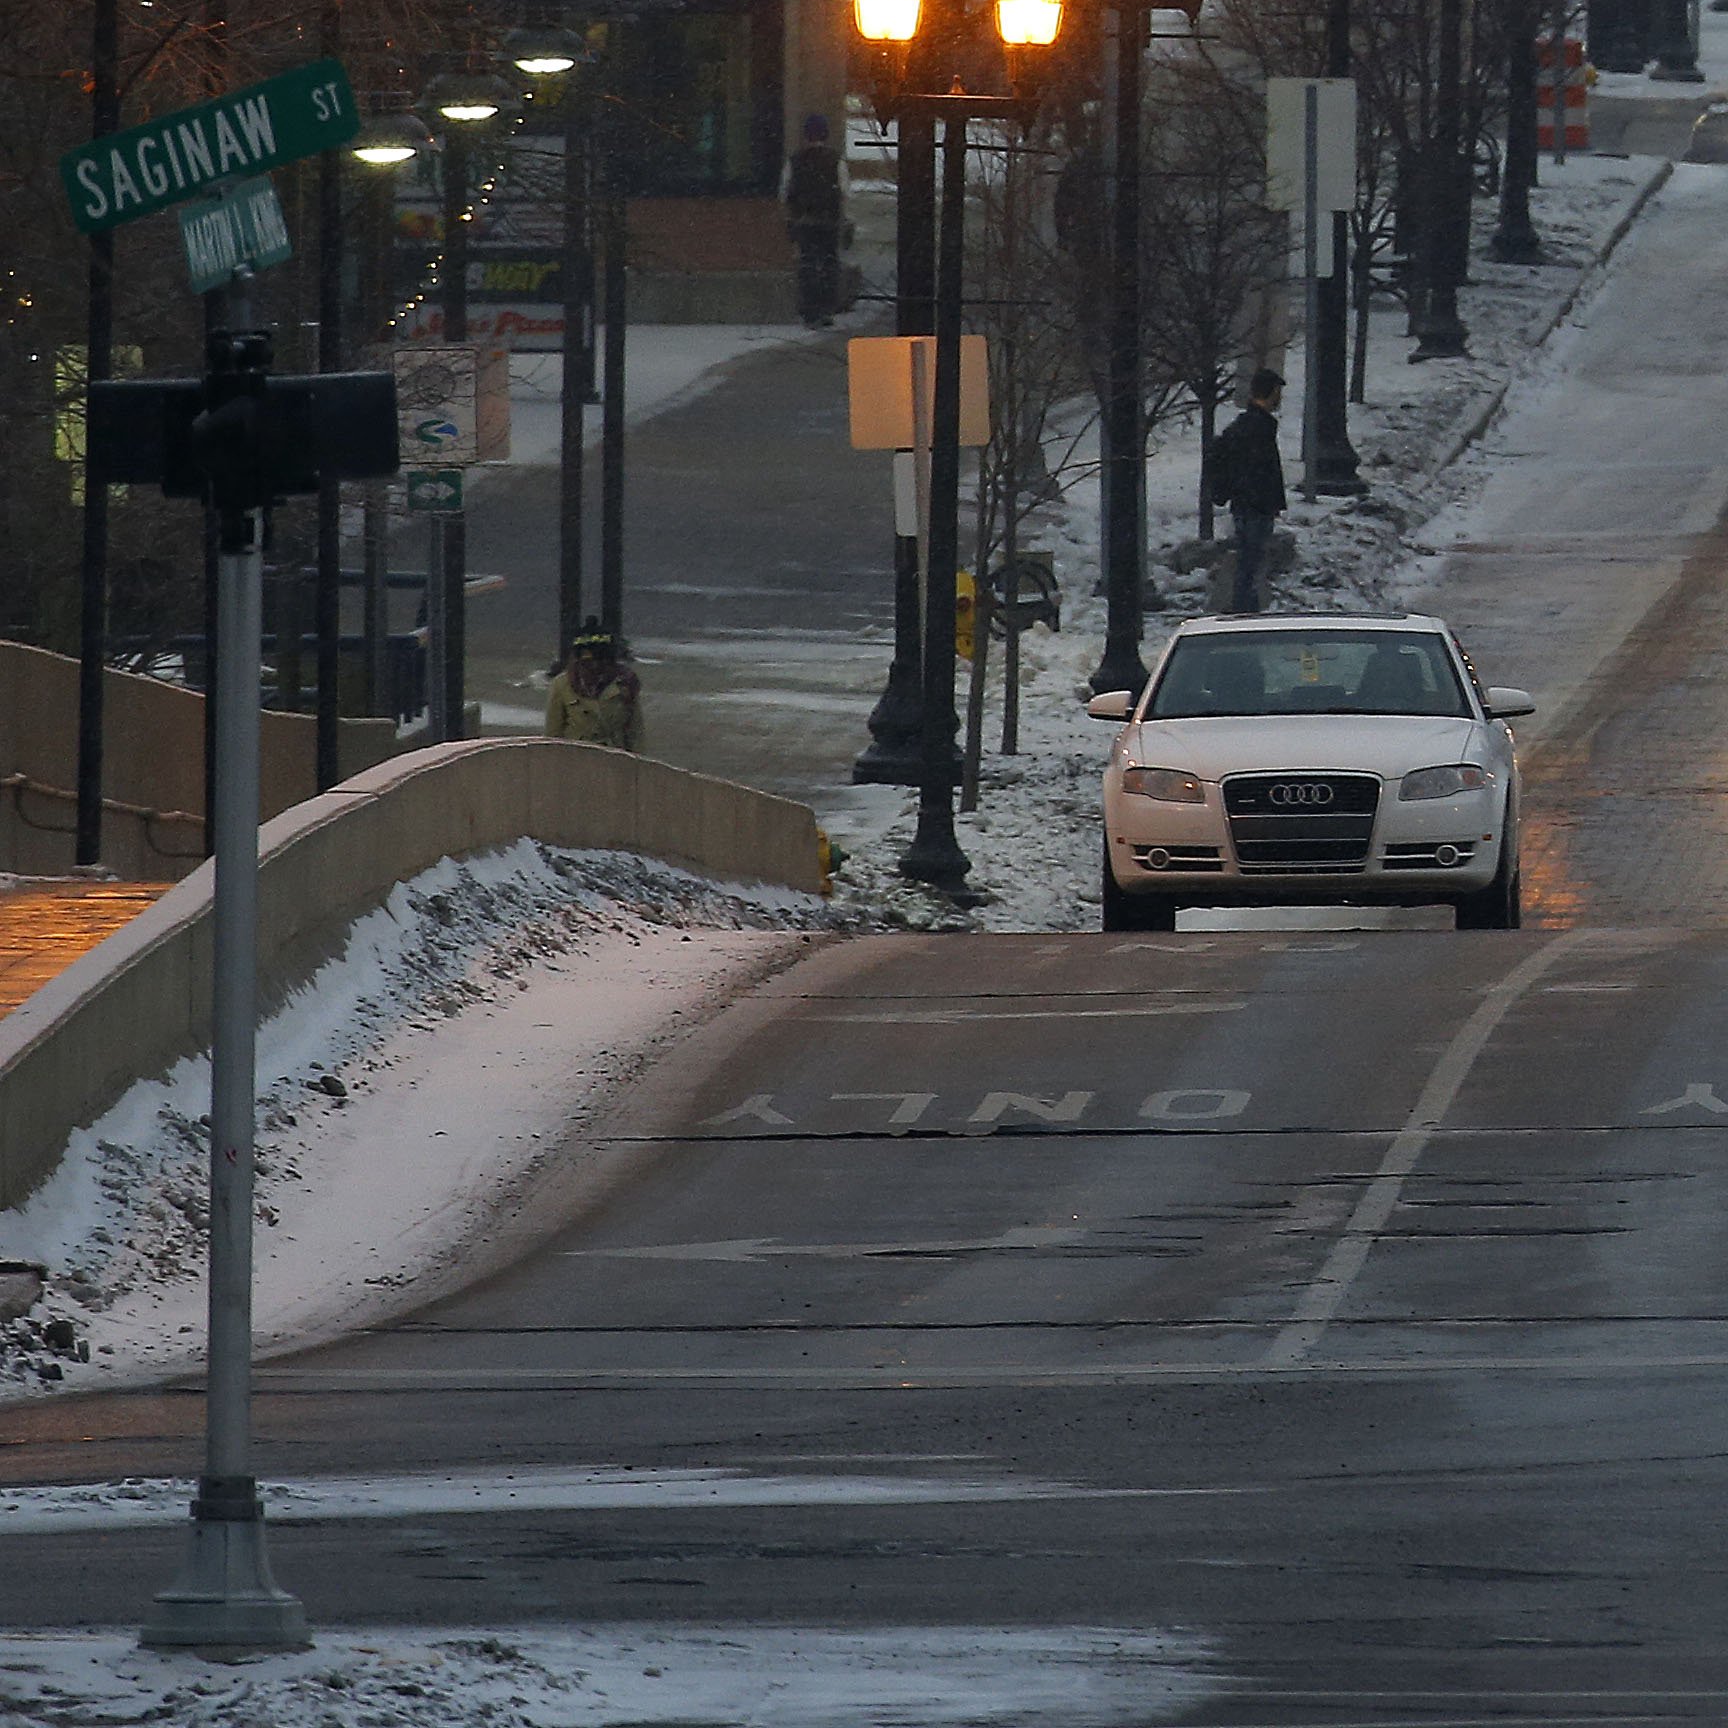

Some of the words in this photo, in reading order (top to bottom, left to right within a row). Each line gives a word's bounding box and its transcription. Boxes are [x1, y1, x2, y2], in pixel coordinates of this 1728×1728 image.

[76, 94, 277, 220] SAGINAW
[311, 81, 342, 122] ST
[183, 206, 238, 278] MARTIN
[247, 188, 290, 256] KING
[697, 1088, 1252, 1127] ONLY
